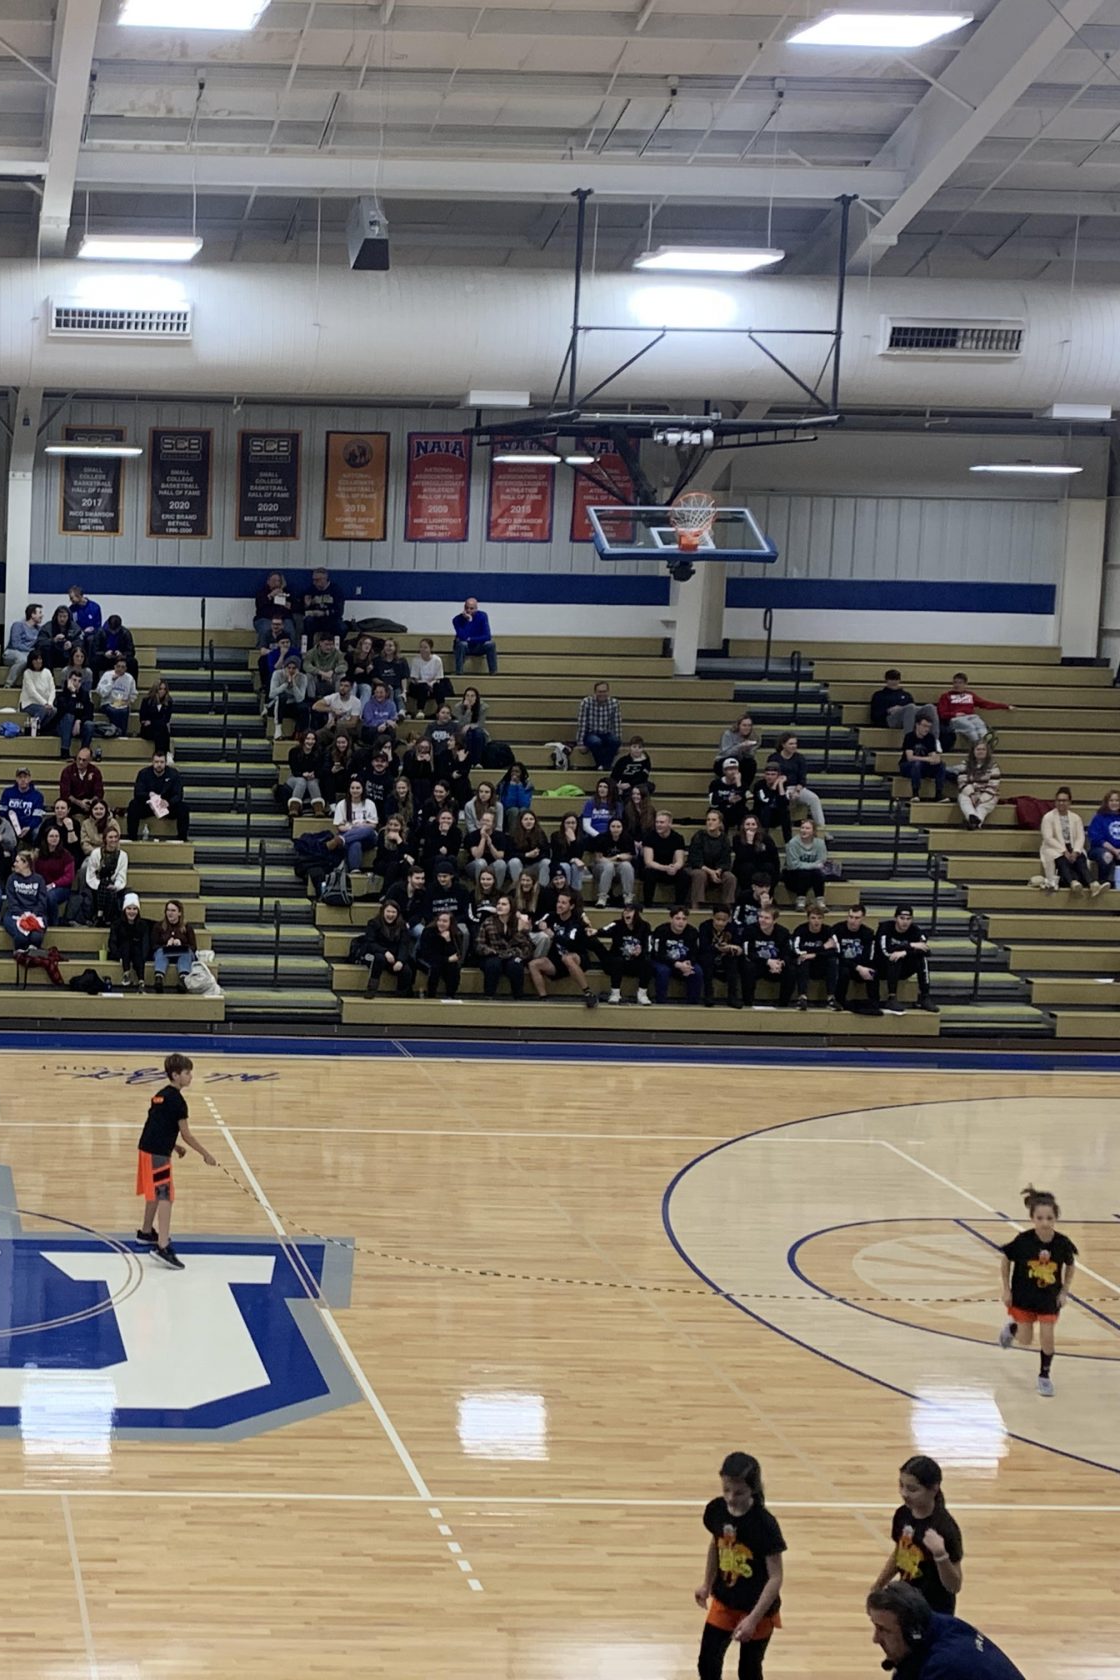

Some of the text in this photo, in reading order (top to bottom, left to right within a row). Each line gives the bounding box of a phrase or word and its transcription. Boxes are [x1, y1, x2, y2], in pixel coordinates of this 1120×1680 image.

[414, 440, 465, 461] NAIA
[82, 498, 102, 506] 2017
[169, 501, 190, 509] 2020
[258, 503, 278, 511] 2020
